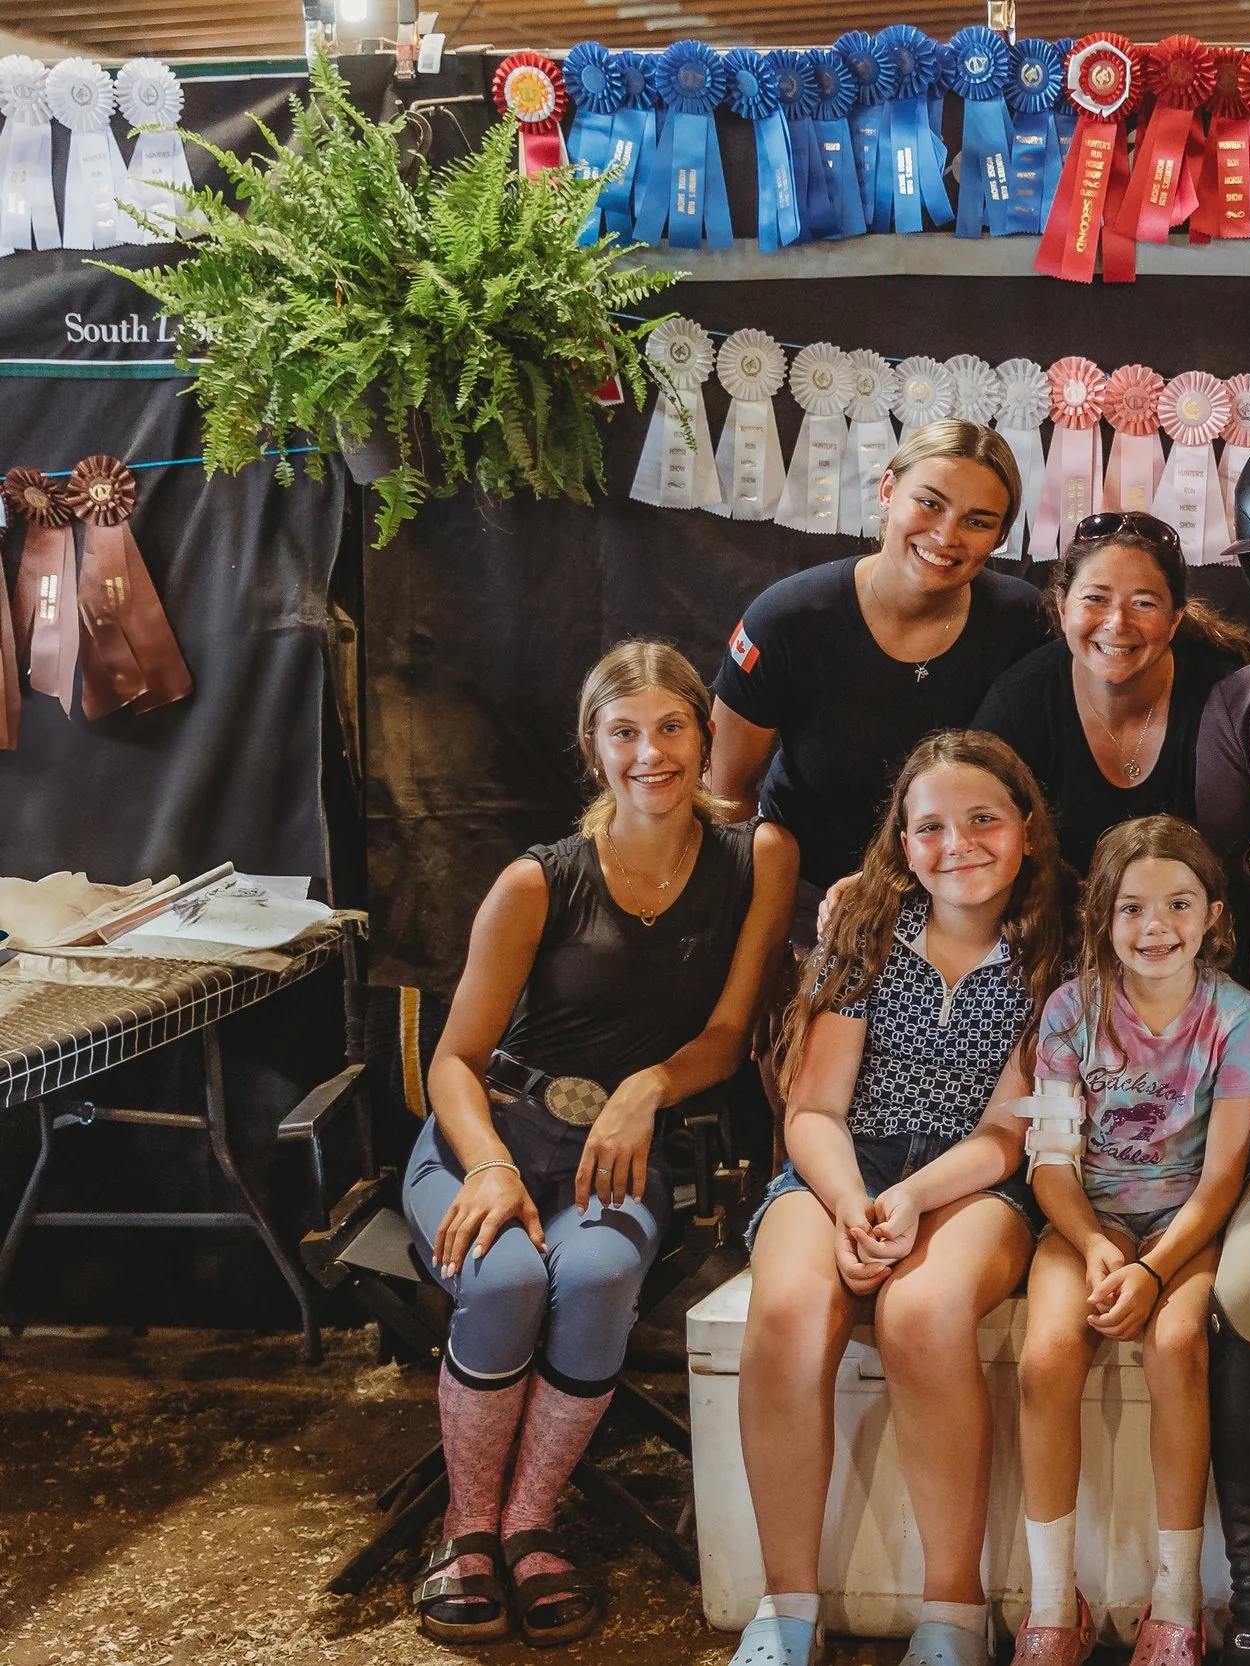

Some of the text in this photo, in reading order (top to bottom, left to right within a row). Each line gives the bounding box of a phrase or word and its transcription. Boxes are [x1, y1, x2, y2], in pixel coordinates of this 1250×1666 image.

[1085, 140, 1111, 150] HUNTER'S
[1219, 141, 1246, 149] HUNTER'S
[1090, 150, 1102, 158] RUN
[1086, 160, 1104, 170] HORSE
[1150, 160, 1165, 203] HORSE SHOW
[1159, 160, 1174, 206] HUNTER'S RUN
[1224, 176, 1243, 184] HORSE
[990, 180, 1000, 200] SHOW
[1226, 193, 1243, 201] SHOW
[1076, 199, 1092, 252] SECOND
[65, 313, 150, 343] South
[1090, 1131, 1162, 1164] Stables
